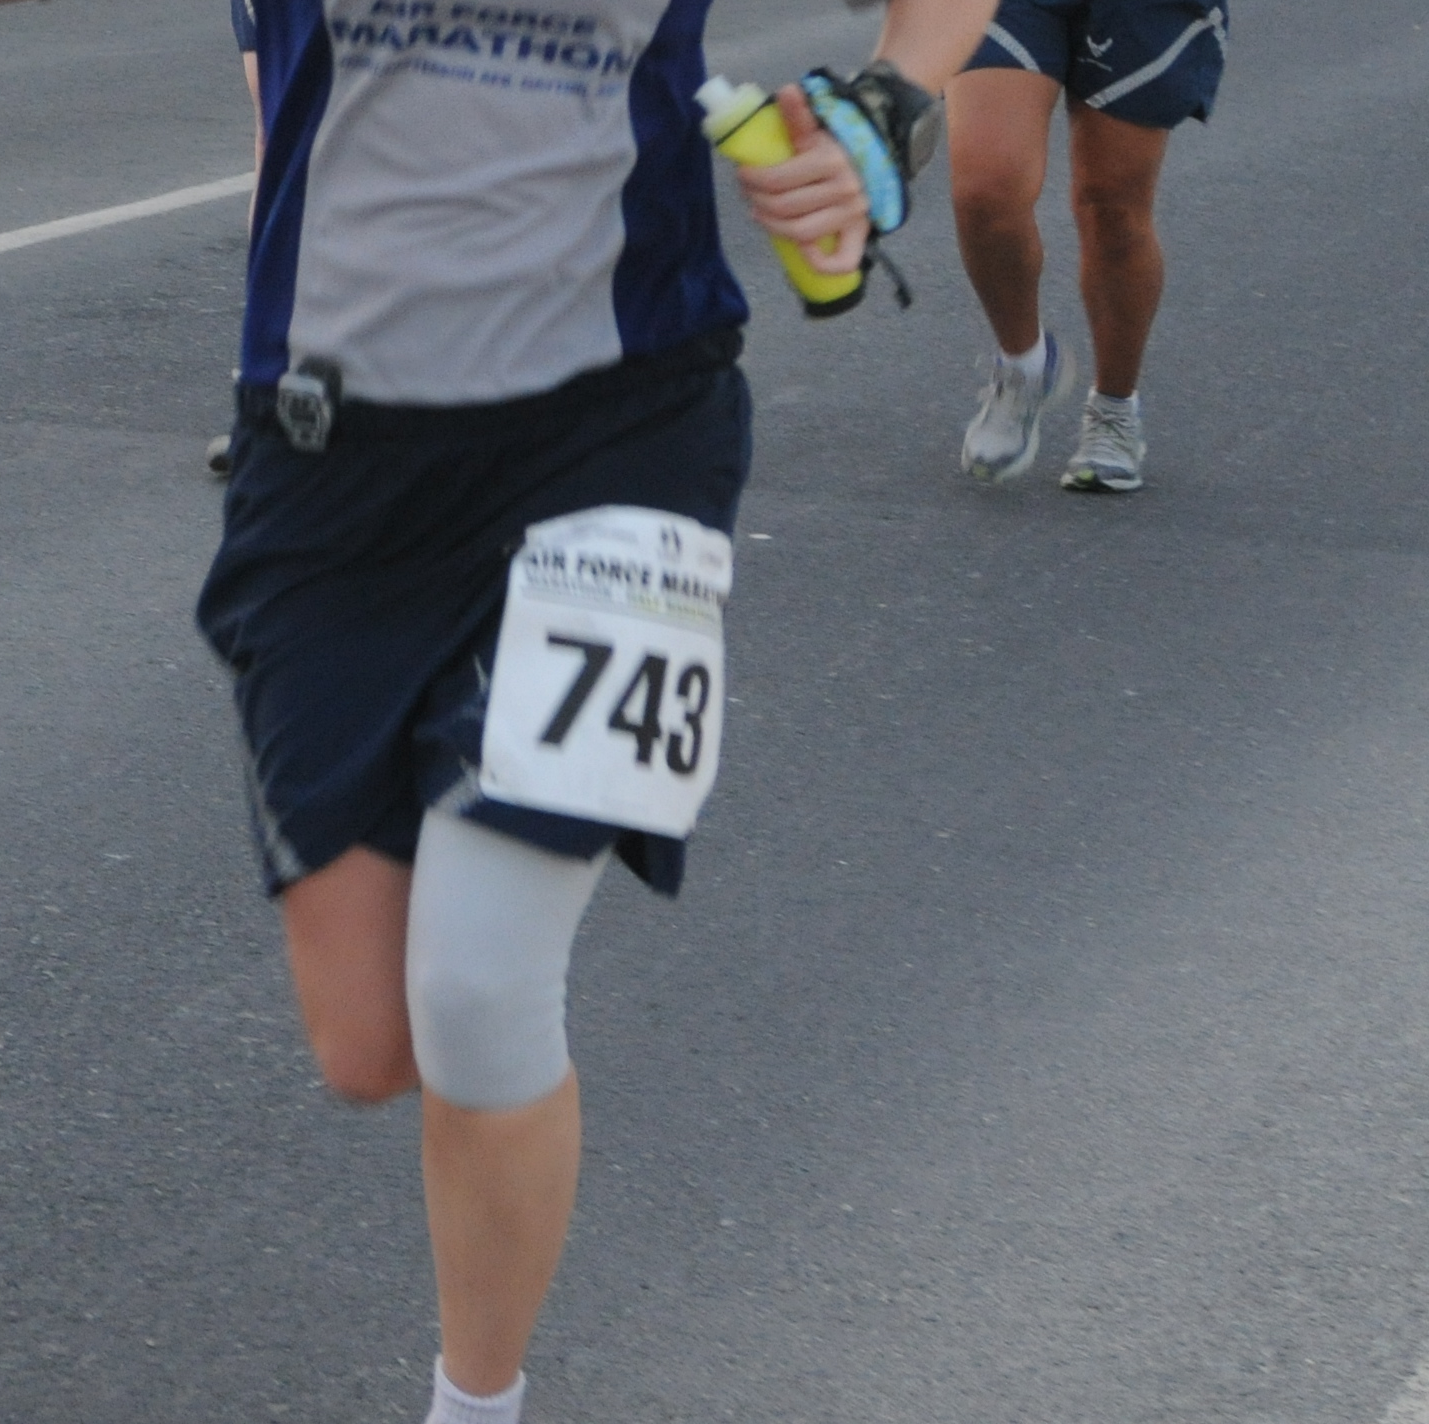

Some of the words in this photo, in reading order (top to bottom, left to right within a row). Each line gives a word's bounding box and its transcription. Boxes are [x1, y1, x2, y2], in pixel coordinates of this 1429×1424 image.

[449, 0, 596, 35] FORCE
[331, 16, 635, 76] MARATHON
[528, 547, 566, 571] AIR
[576, 552, 651, 586] FORCE
[539, 630, 711, 776] 743
